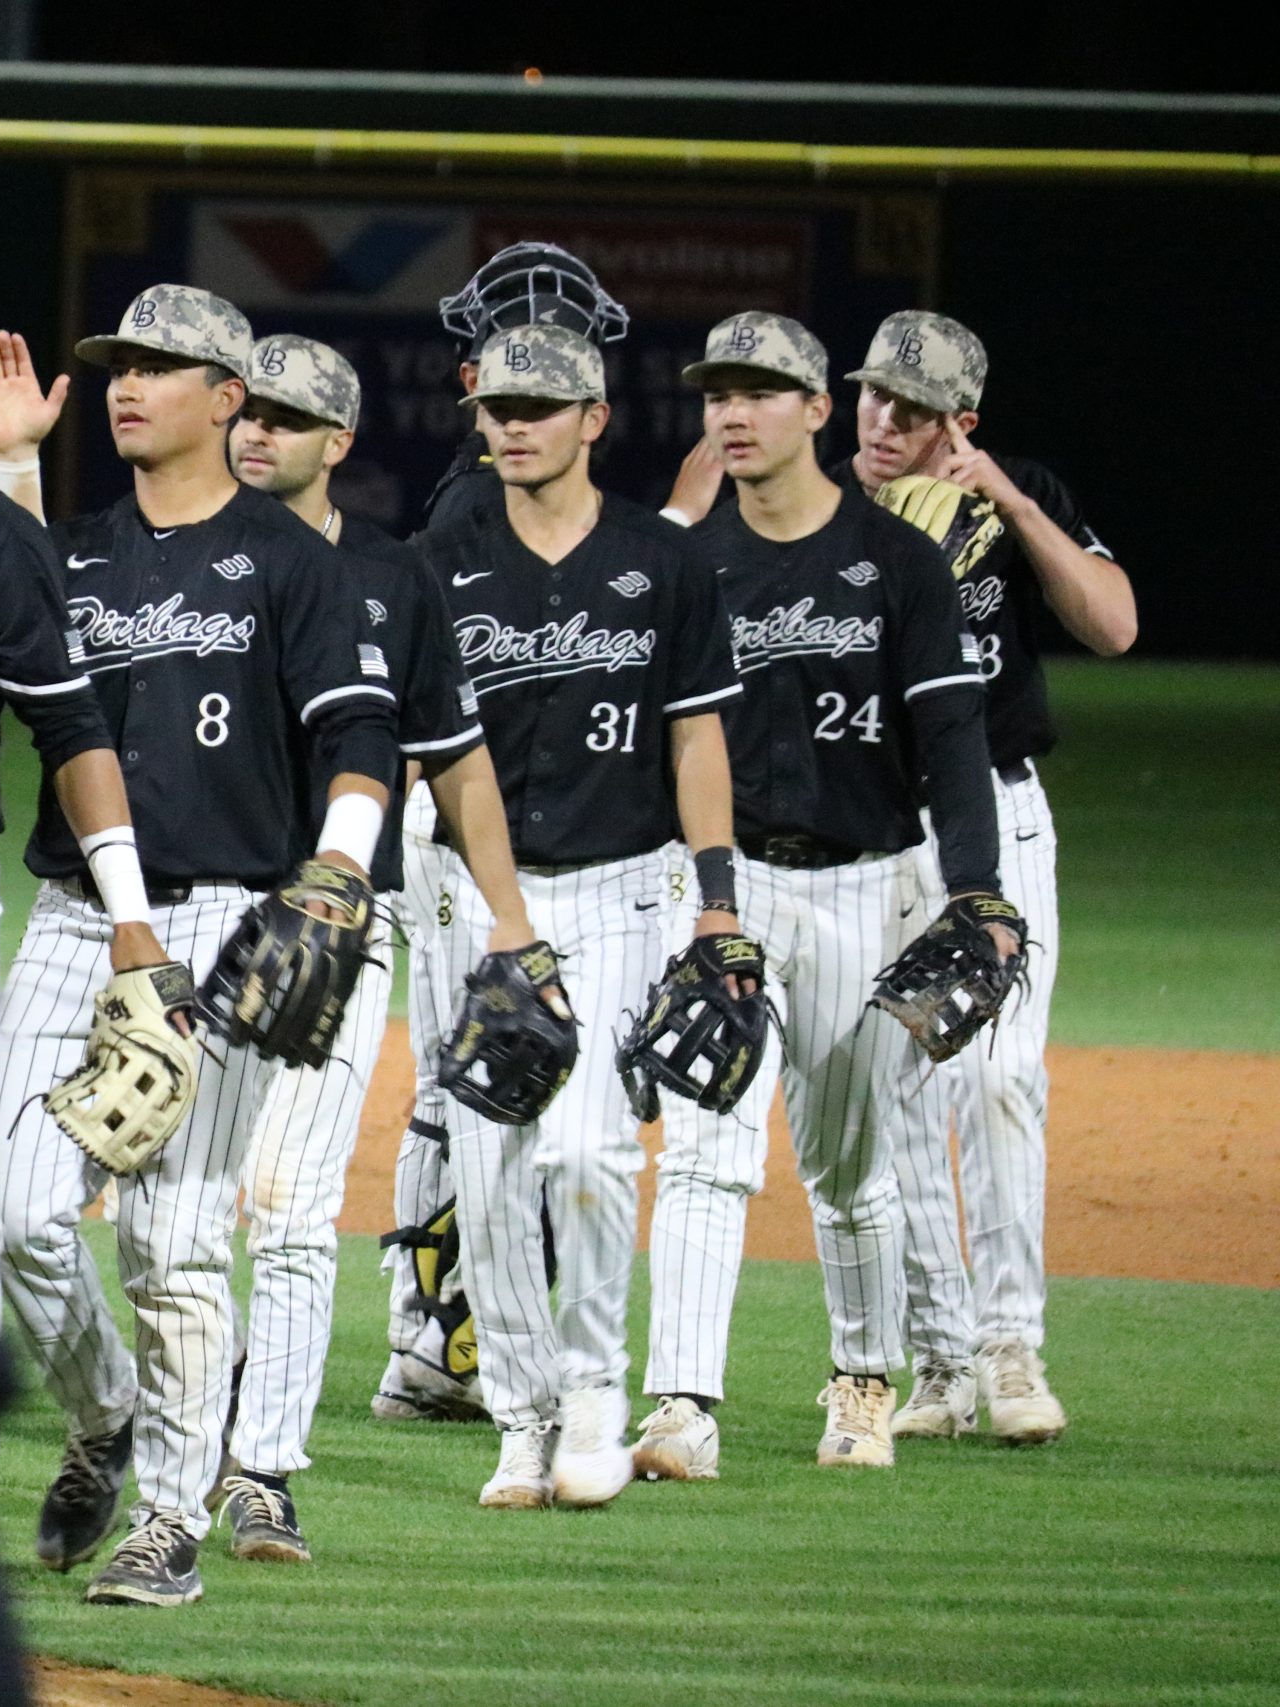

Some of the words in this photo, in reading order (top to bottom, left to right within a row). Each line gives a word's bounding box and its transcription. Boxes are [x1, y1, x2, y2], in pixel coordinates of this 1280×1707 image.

[66, 592, 256, 657] Dirtbags
[453, 611, 657, 673] Dirtbags
[730, 597, 884, 658] irtbags
[195, 692, 231, 747] 8
[585, 701, 639, 753] 31
[813, 691, 884, 744] 24
